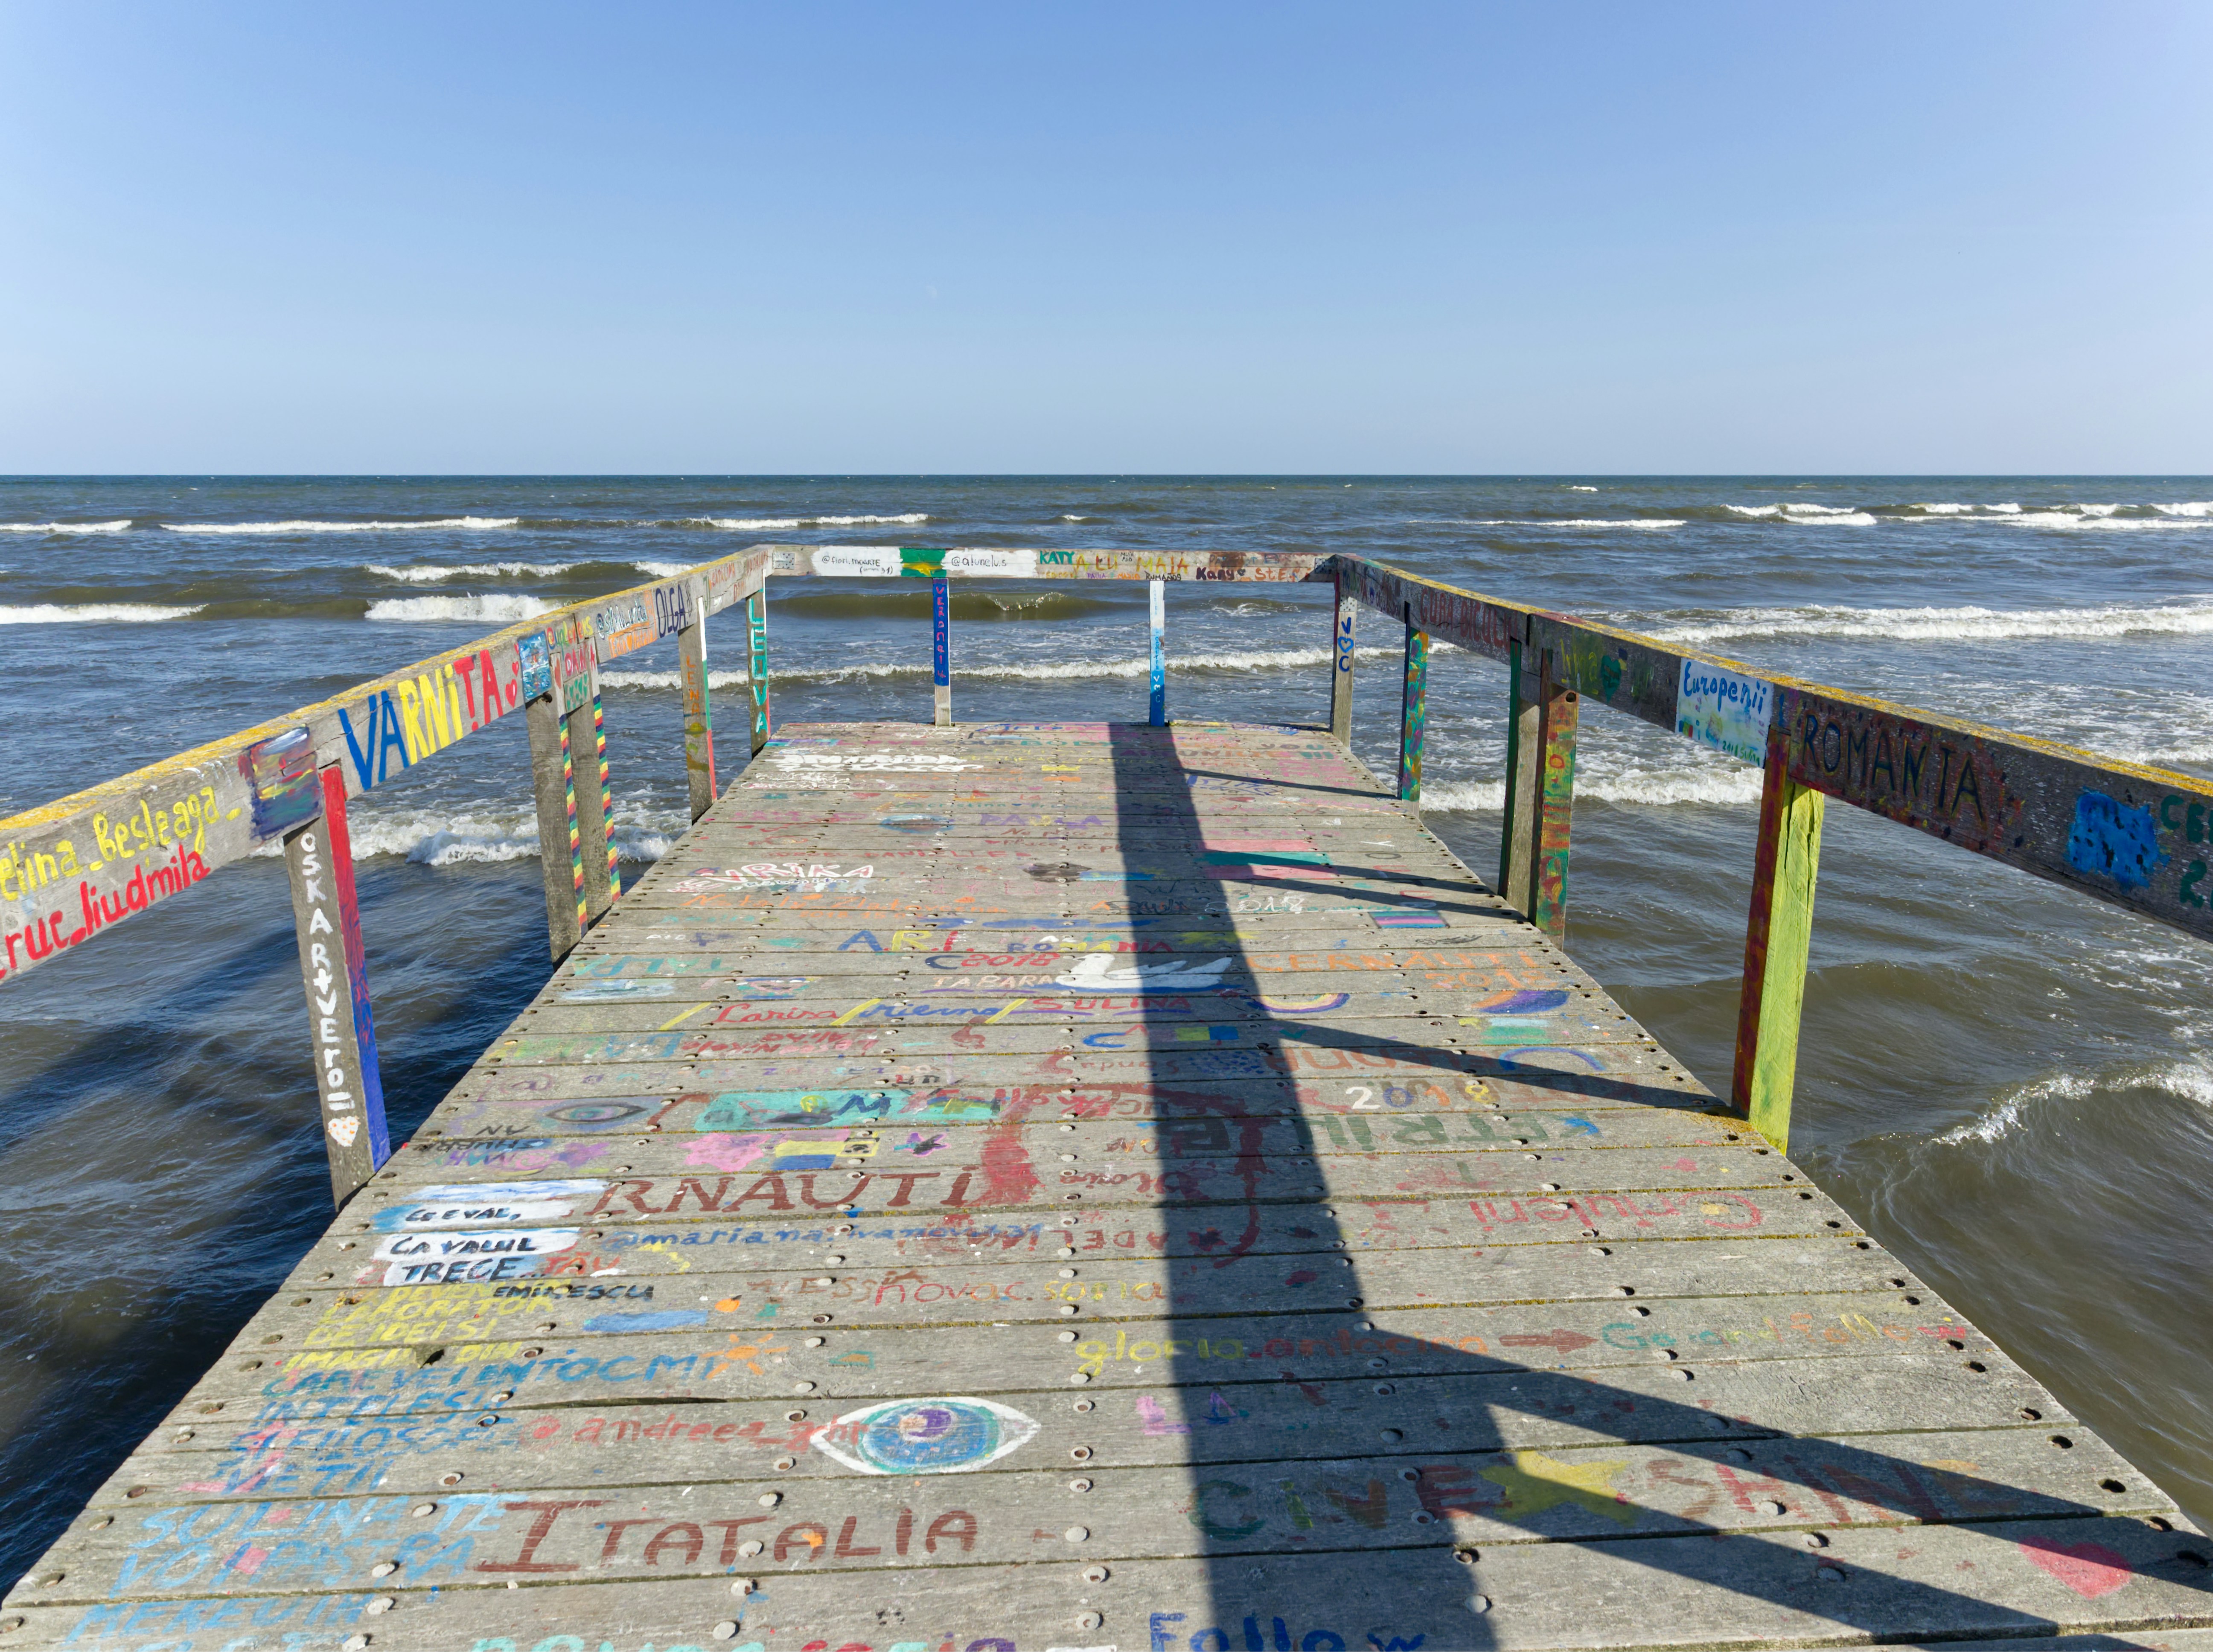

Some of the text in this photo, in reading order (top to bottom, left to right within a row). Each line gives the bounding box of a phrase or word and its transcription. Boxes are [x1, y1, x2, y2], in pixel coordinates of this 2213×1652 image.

[1040, 550, 1074, 565] KATY
[686, 655, 700, 716] LENA
[749, 598, 768, 734] LEOVA
[1468, 1191, 1763, 1231] Criuleni
